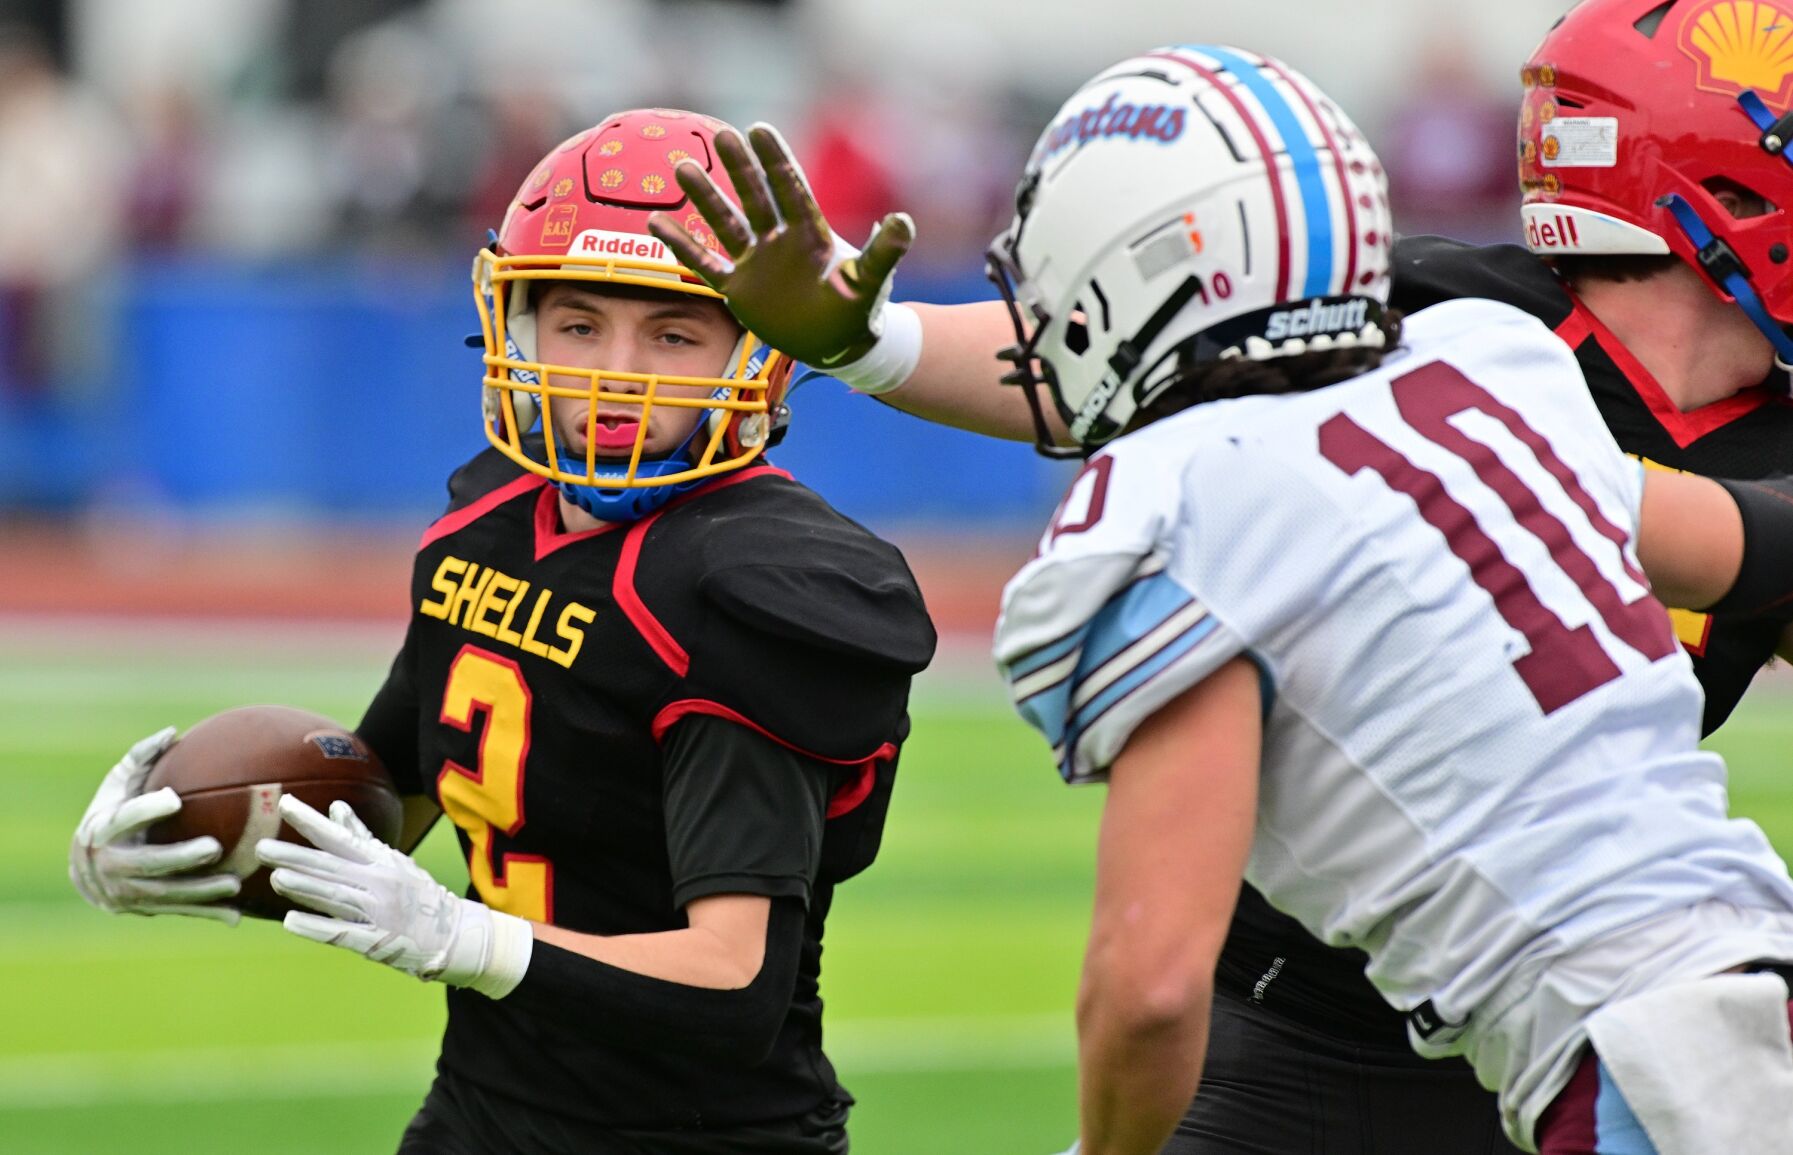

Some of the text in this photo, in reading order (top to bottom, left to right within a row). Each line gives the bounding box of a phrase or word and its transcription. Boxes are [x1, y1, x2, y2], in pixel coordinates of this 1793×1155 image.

[582, 234, 665, 260] Riddell
[1264, 297, 1369, 341] schutt
[1034, 454, 1114, 558] 0
[1317, 358, 1678, 717] 10
[419, 554, 597, 669] SHELLS
[436, 642, 554, 925] 2
